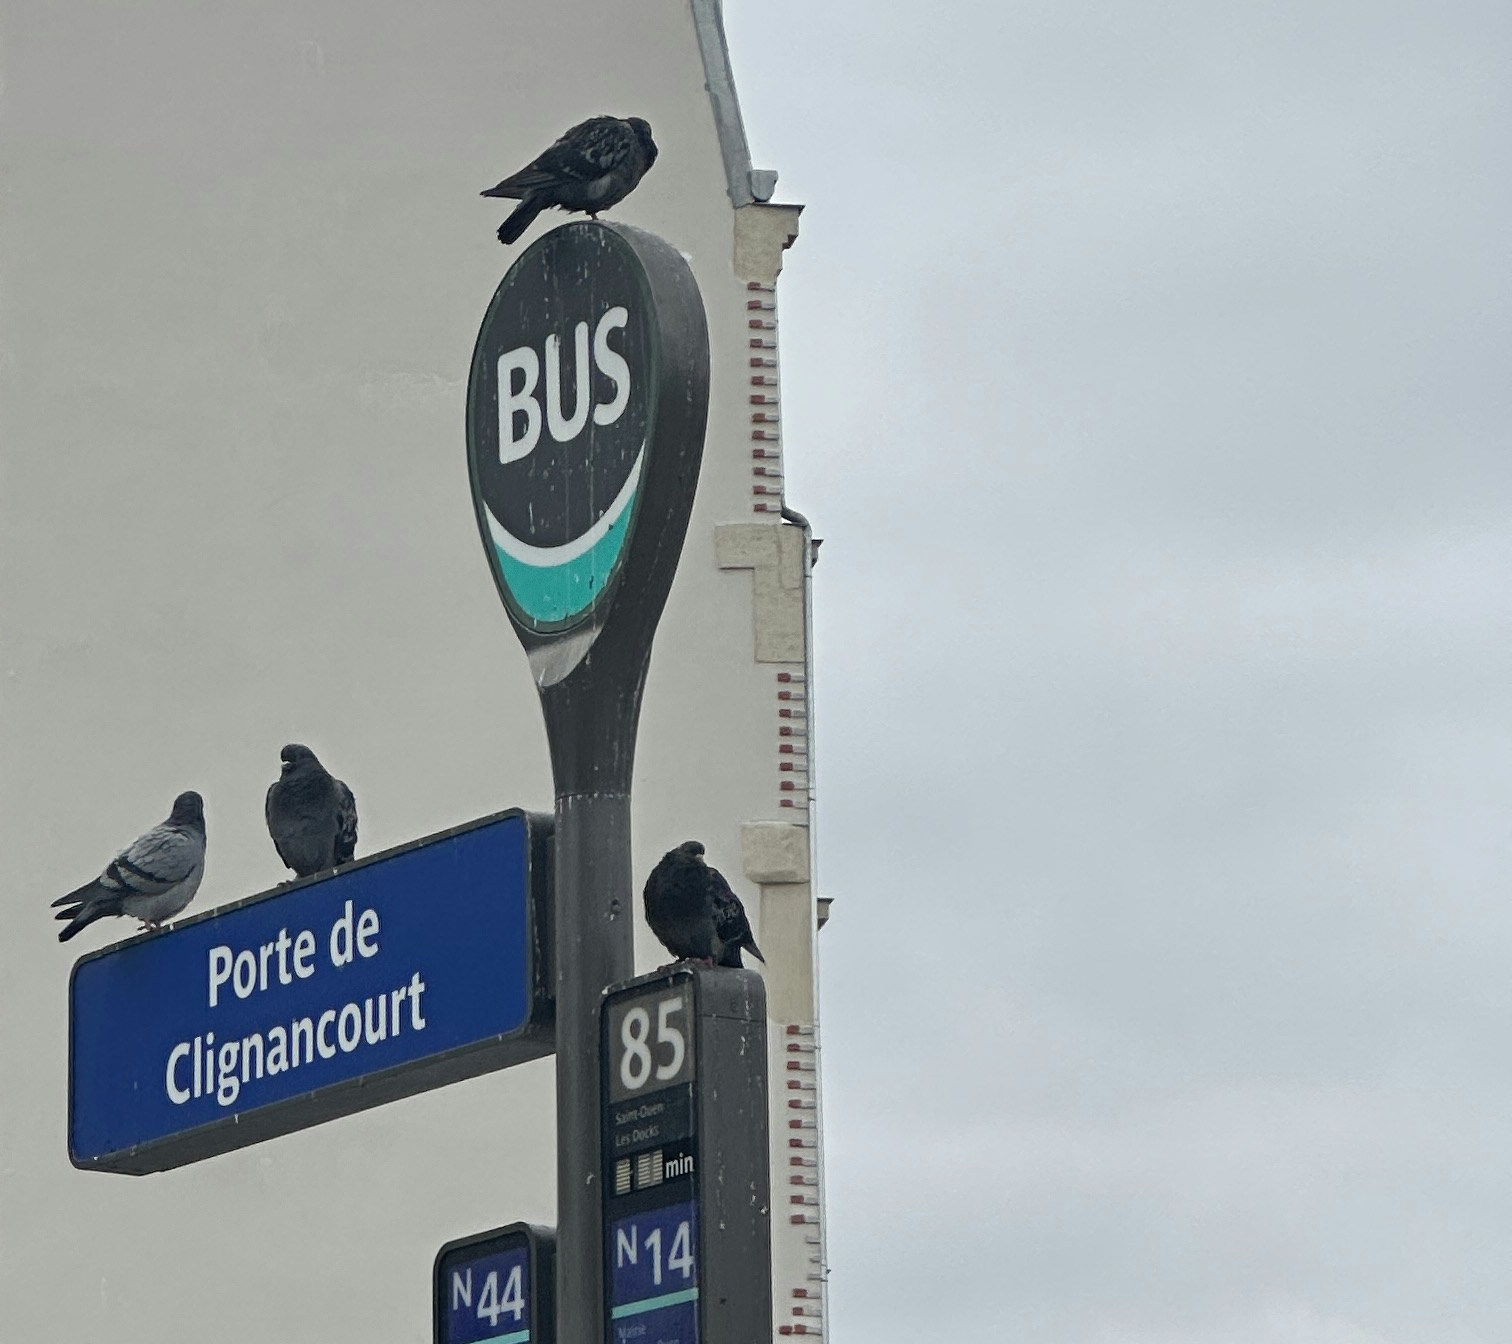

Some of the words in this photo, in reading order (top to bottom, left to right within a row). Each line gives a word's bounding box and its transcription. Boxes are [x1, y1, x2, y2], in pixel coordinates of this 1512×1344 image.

[497, 306, 631, 465] BUS
[209, 927, 316, 1008] Porte
[329, 899, 380, 967] de
[166, 971, 427, 1106] Clignancourt
[620, 997, 685, 1090] 85
[665, 1152, 694, 1179] min
